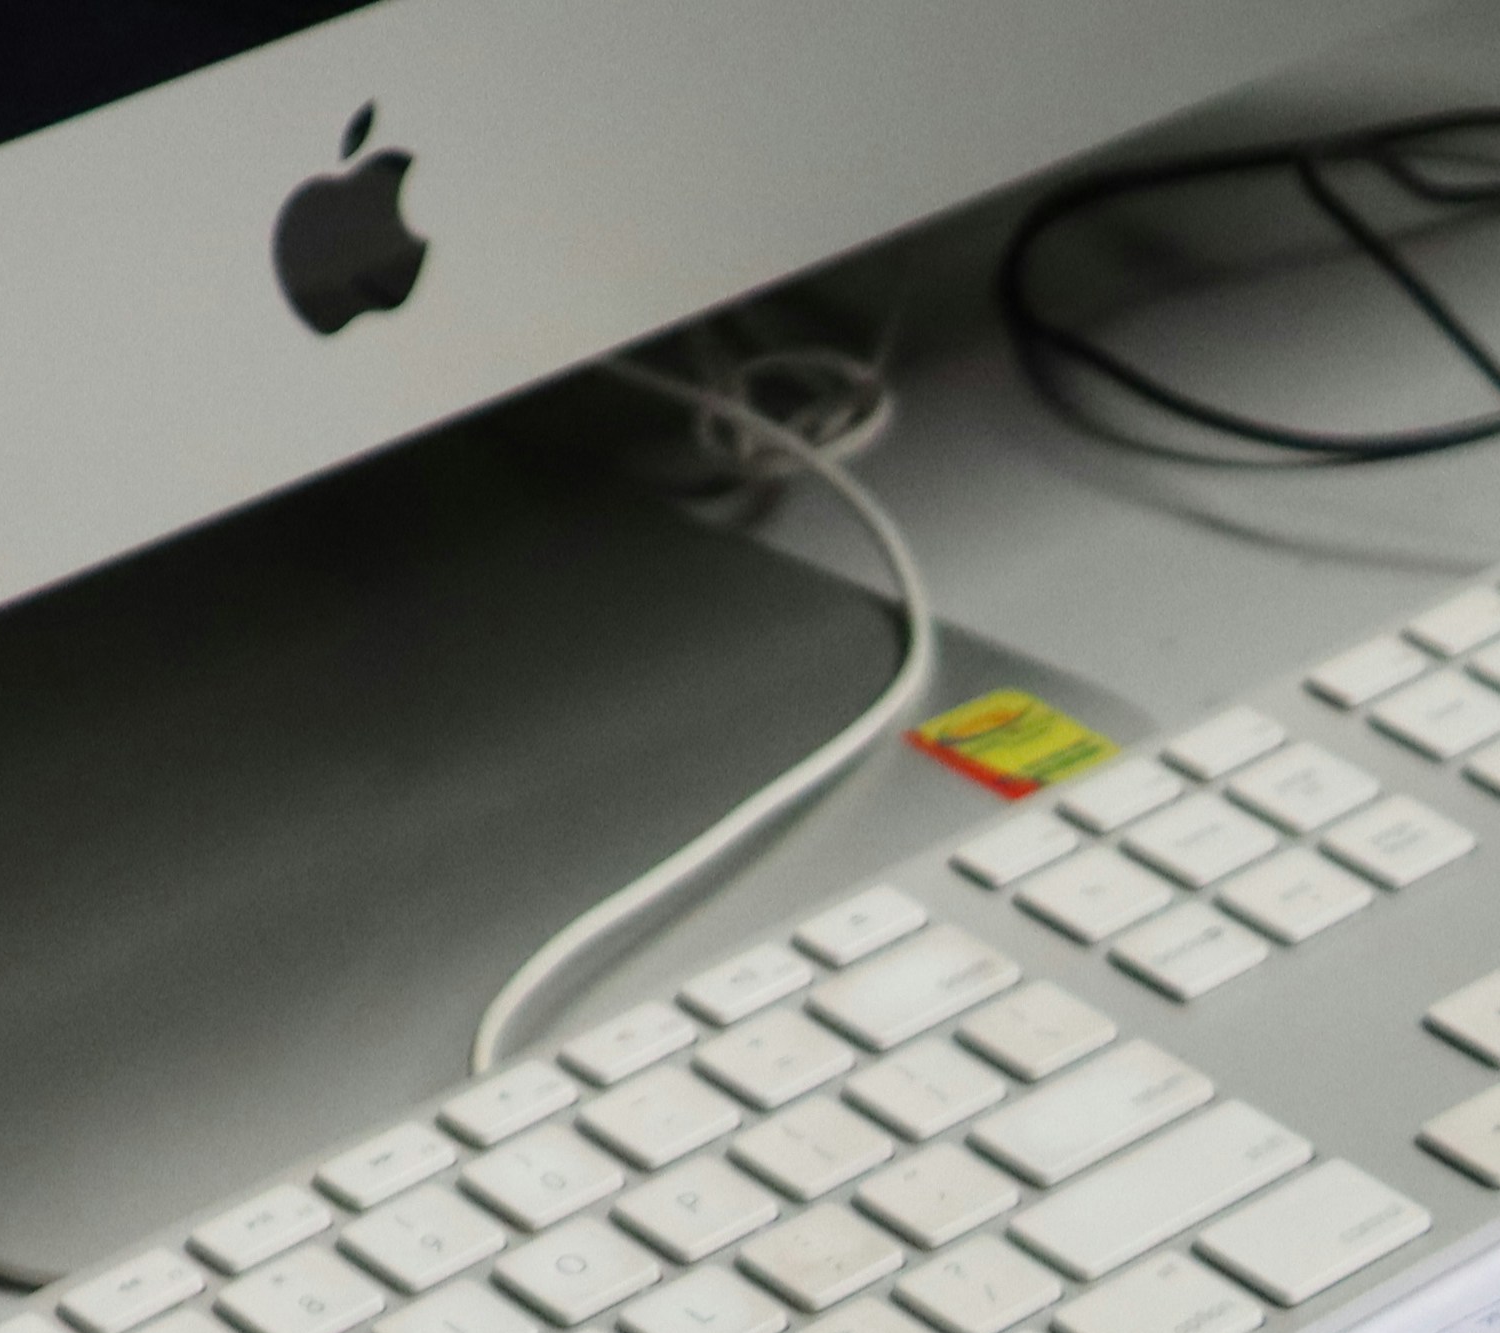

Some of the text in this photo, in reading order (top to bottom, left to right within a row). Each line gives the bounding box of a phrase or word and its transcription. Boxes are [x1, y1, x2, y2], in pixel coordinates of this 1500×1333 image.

[675, 1191, 701, 1213] P
[556, 1253, 588, 1277] O
[689, 1305, 718, 1325] L
